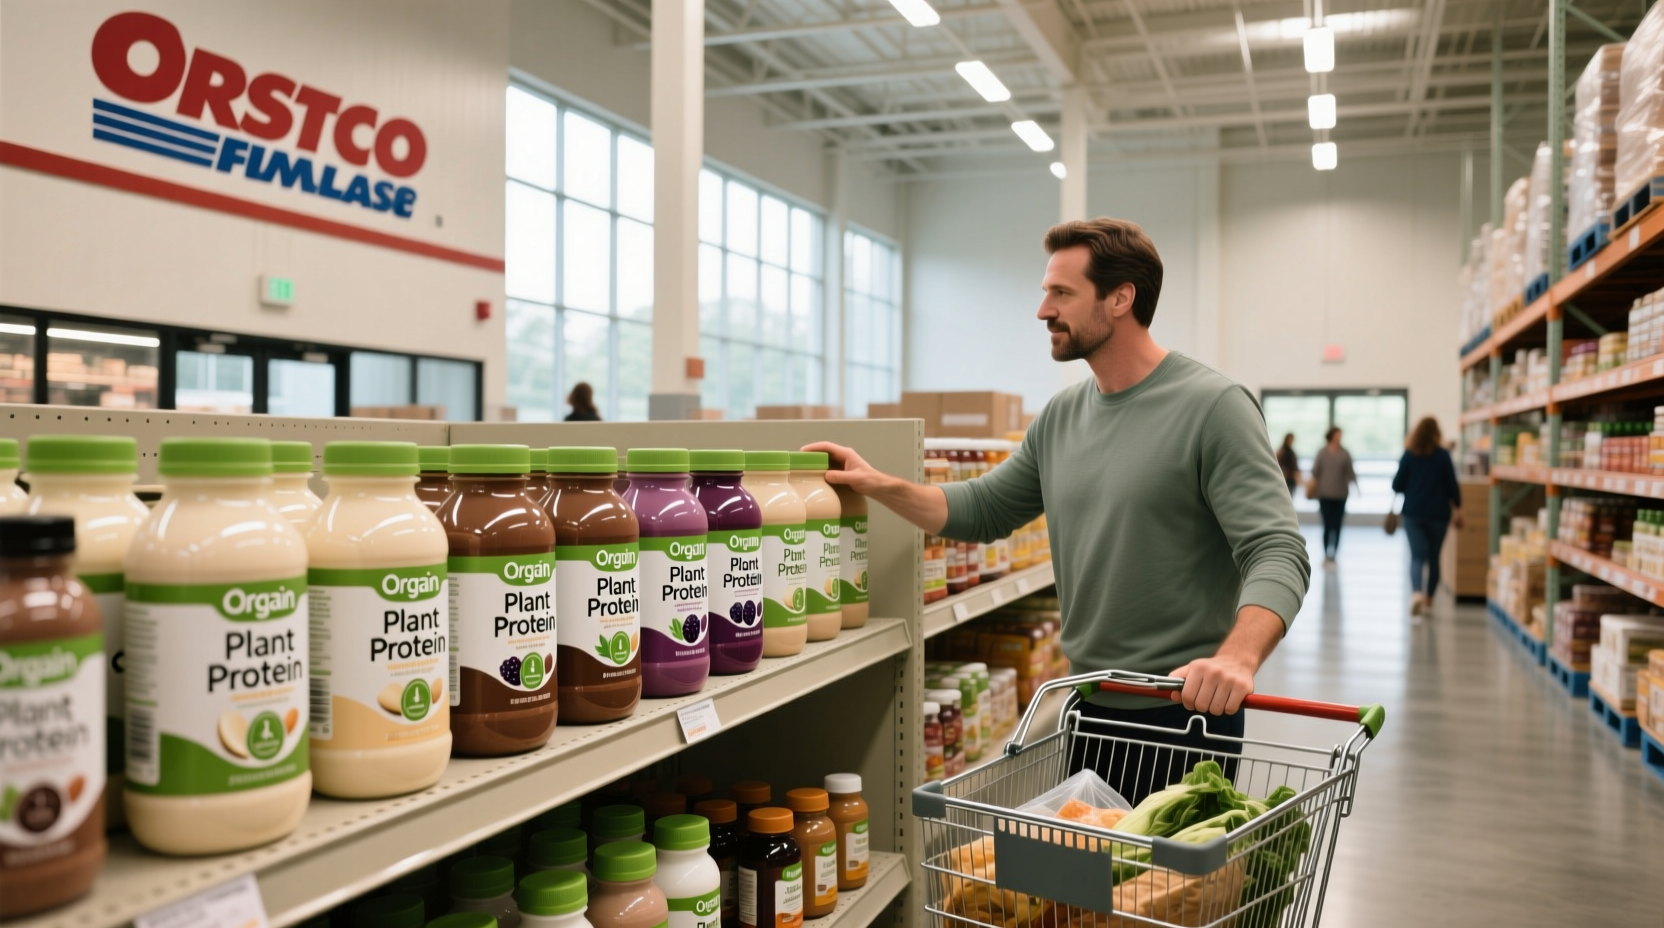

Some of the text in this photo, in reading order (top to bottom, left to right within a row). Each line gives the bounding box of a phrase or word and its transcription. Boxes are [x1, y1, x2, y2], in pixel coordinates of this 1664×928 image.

[91, 11, 427, 178] ORSTCO
[670, 566, 705, 582] Plant
[731, 557, 759, 572] Plant
[597, 576, 636, 596] Plant
[222, 586, 296, 620] Orgain
[505, 591, 551, 613] Plant
[587, 595, 639, 617] Protein
[384, 607, 440, 634] Plant
[494, 612, 556, 638] Protein
[226, 629, 295, 660] Plant
[371, 632, 446, 661] Protein
[208, 656, 303, 692] Protein
